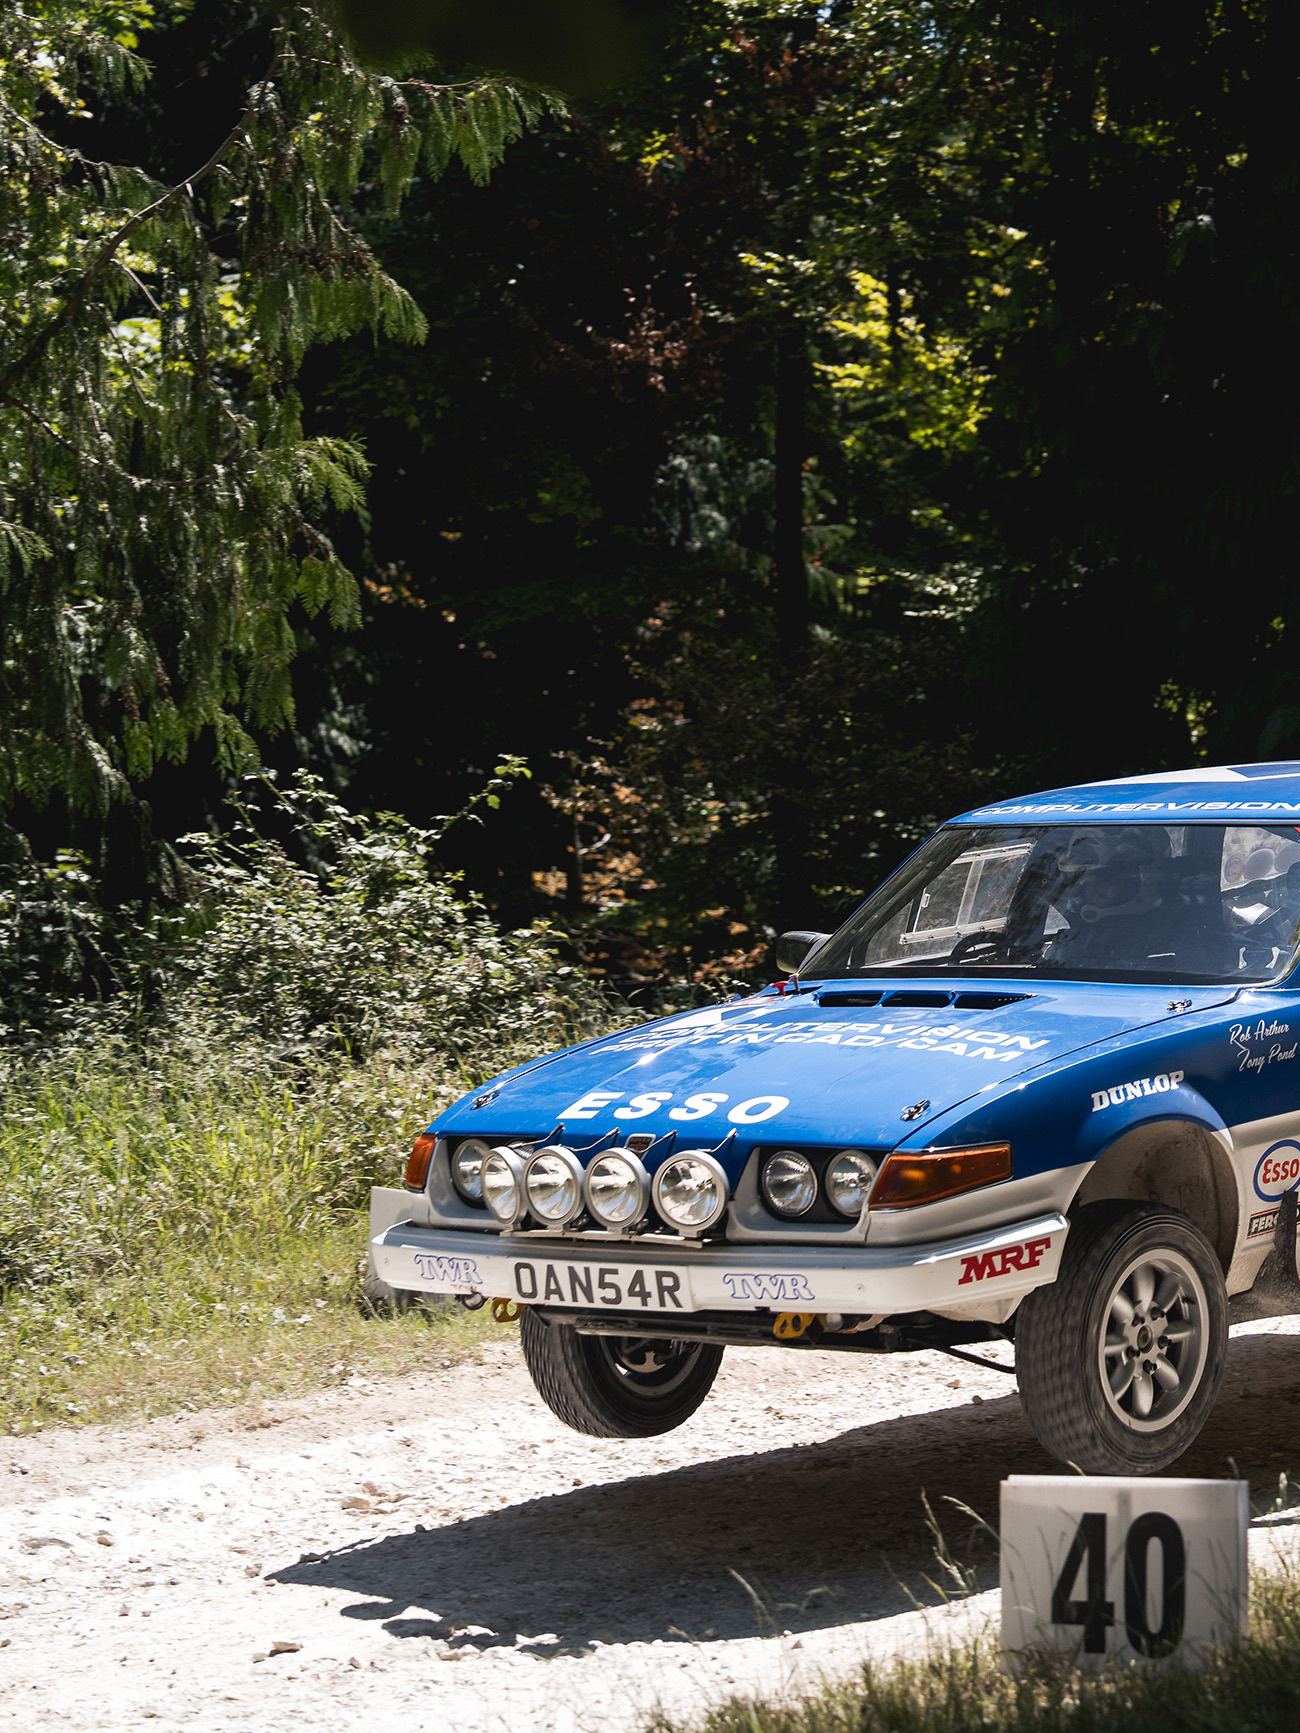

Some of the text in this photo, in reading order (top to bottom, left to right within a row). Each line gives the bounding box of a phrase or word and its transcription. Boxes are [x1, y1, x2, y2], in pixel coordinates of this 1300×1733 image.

[772, 1032, 1026, 1062] CAD/CAM
[1229, 1019, 1290, 1049] Rob Arthur
[1236, 1043, 1298, 1073] Tony Pond
[1091, 1070, 1185, 1112] DUNLOP
[557, 1091, 790, 1125] ESSO
[414, 1253, 484, 1286] TWR
[958, 1237, 1052, 1286] MRF
[723, 1272, 815, 1301] TWR
[1051, 1511, 1186, 1659] 40
